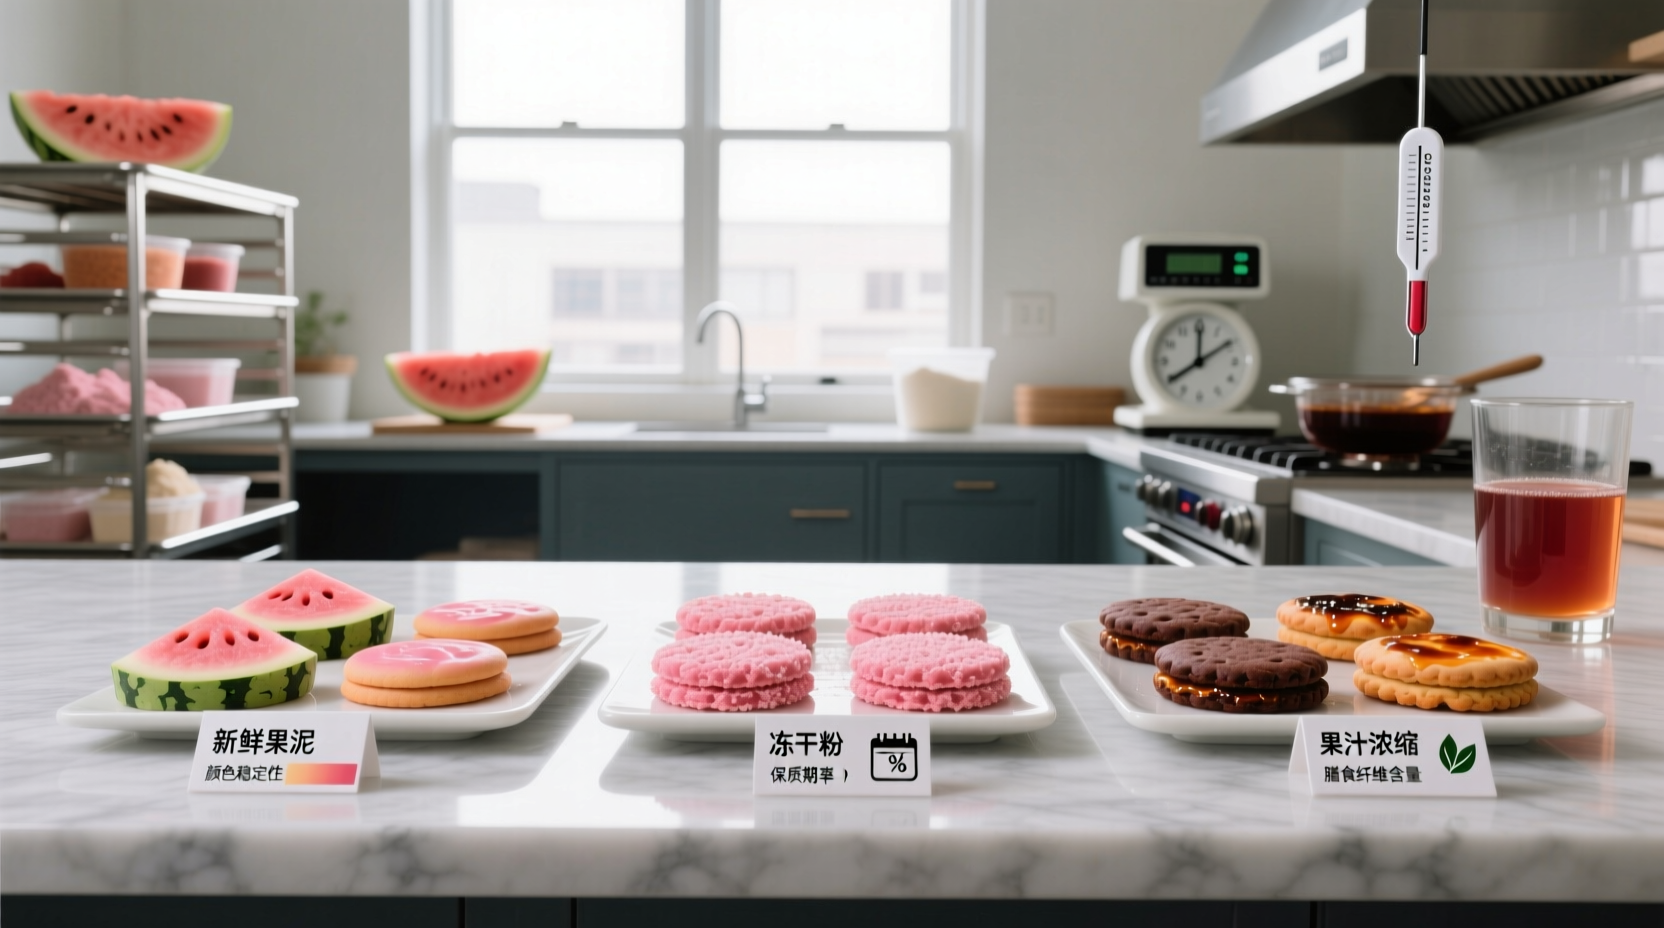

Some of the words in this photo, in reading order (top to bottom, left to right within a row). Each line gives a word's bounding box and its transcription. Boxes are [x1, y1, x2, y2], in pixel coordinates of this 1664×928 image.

[212, 727, 315, 756] 新鲜果泥
[769, 729, 844, 757] 冻干粉
[1320, 730, 1419, 757] 果汁浓缩
[888, 753, 907, 773] %
